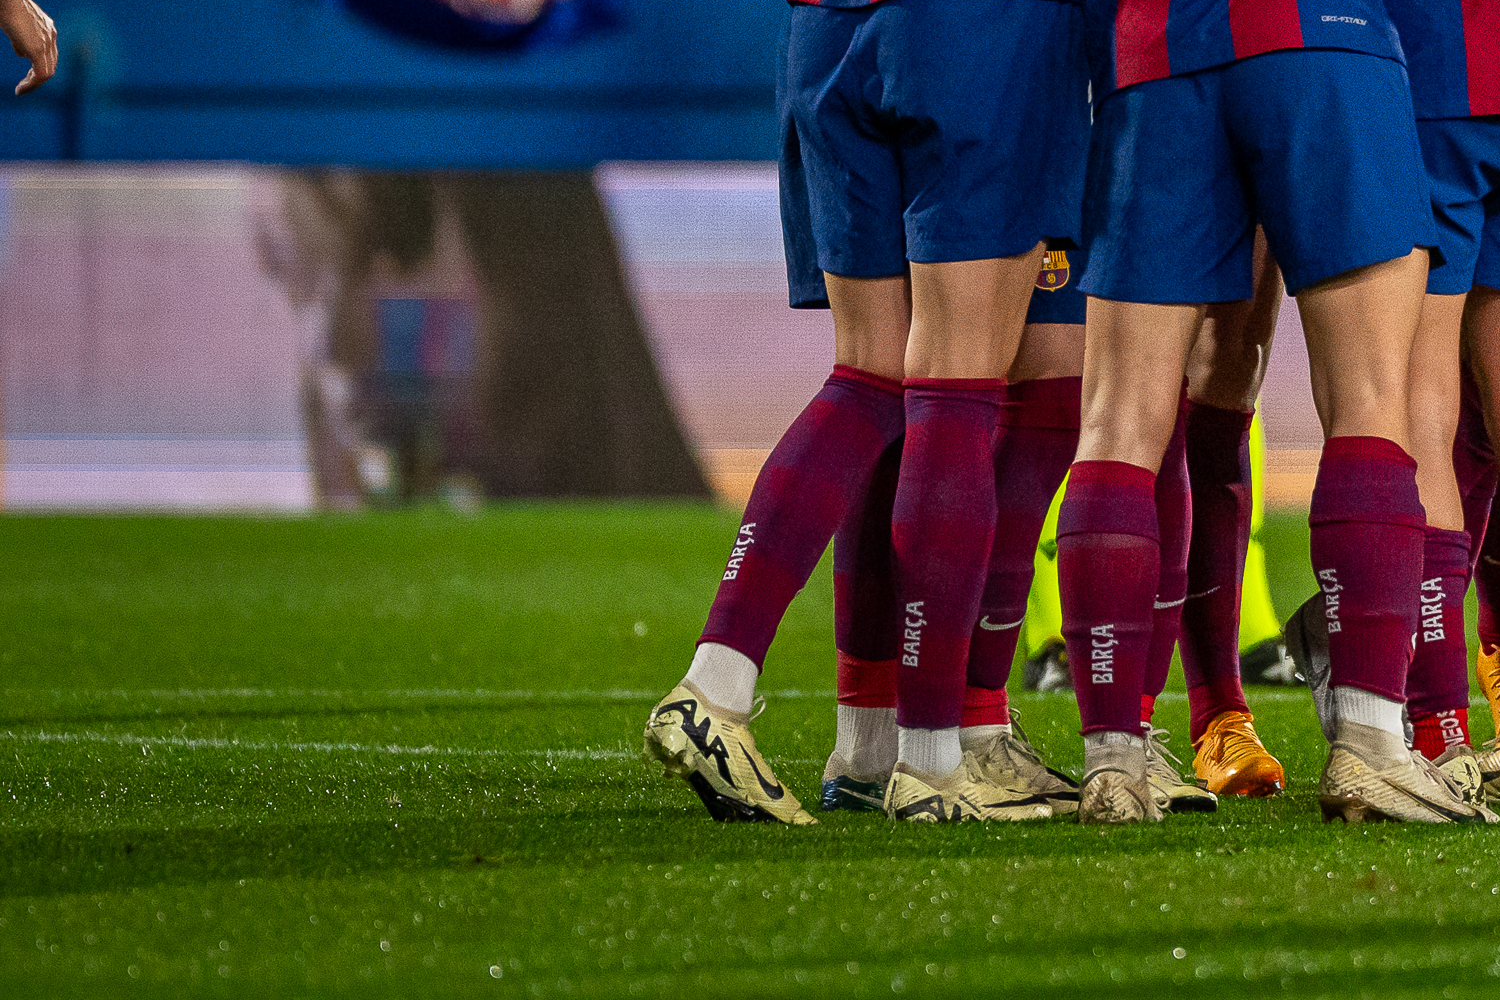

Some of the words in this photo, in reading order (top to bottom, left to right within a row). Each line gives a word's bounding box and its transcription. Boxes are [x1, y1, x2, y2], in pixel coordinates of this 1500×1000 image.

[722, 522, 756, 580] BARÇA
[1319, 568, 1344, 633] BARÇA
[1420, 577, 1447, 643] BARÇA
[902, 601, 927, 668] BARÇA
[1091, 624, 1119, 685] BARÇA
